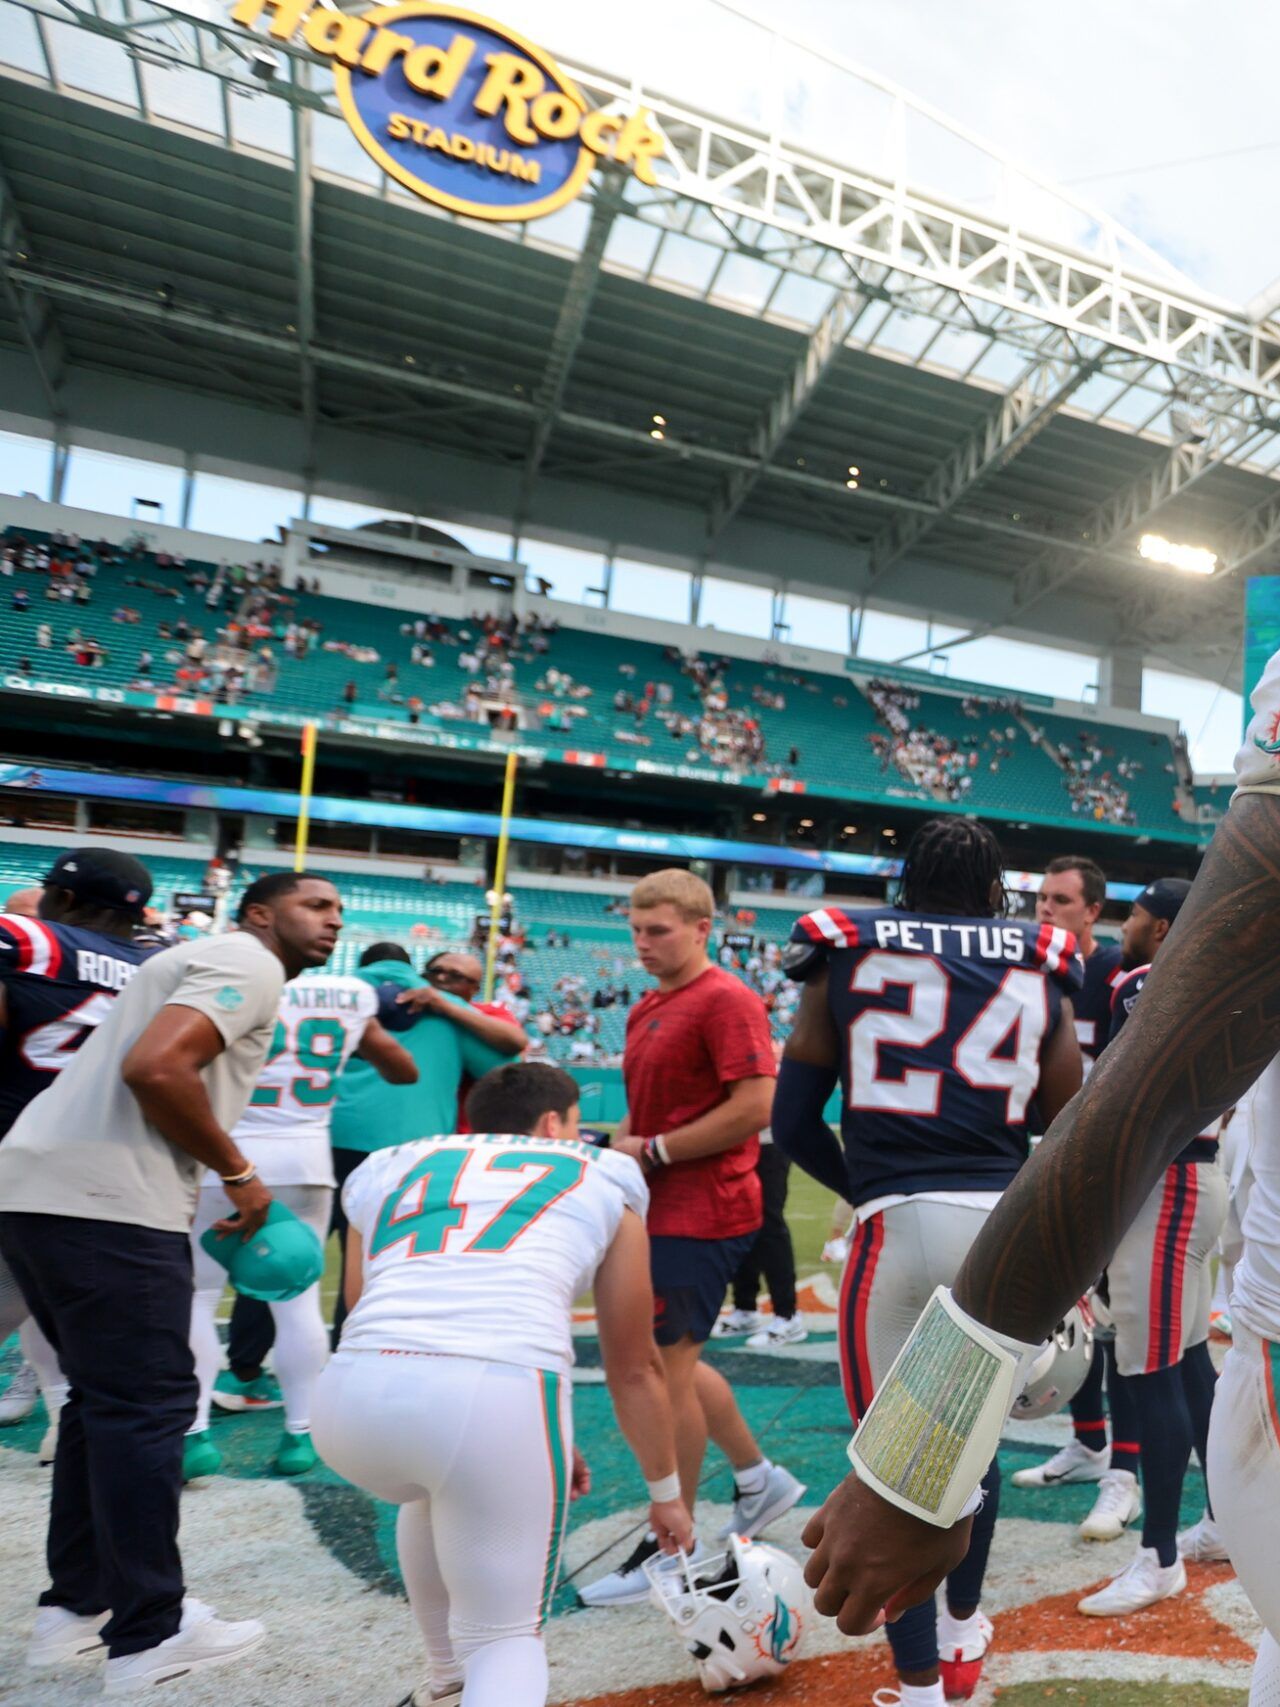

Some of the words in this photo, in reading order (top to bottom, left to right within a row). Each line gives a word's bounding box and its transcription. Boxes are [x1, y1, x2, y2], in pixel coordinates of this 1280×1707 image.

[231, 0, 476, 99] Hard
[473, 51, 666, 187] Rock
[387, 112, 543, 184] STADIUM
[76, 949, 140, 991] ROB
[875, 919, 1024, 962] PETTUS
[281, 986, 361, 1012] ATRICK
[849, 949, 1048, 1125] 24
[368, 1148, 588, 1261] 47
